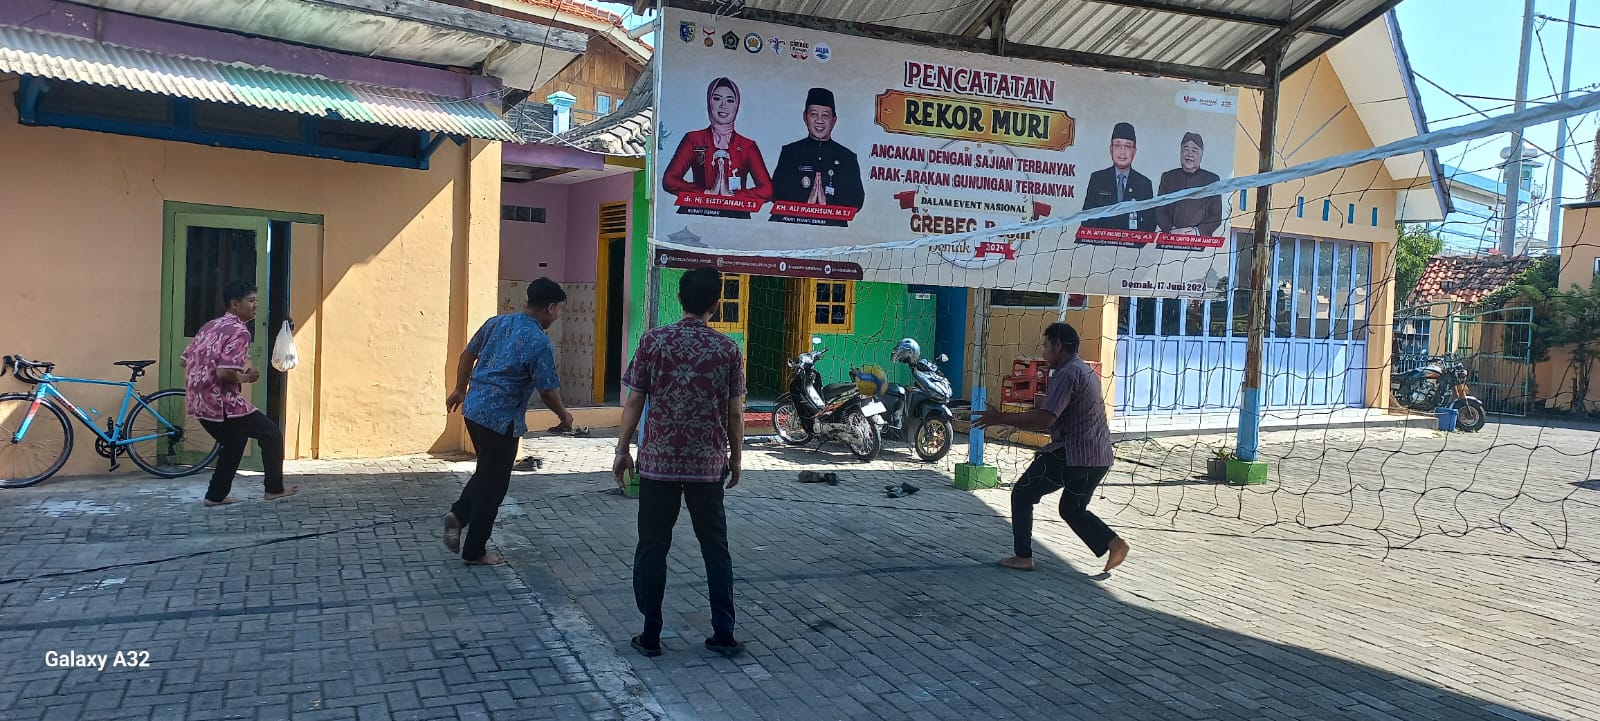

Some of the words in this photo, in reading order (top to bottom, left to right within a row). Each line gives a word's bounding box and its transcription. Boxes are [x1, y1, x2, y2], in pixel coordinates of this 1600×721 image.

[906, 61, 1055, 102] PENCATATAN
[905, 100, 984, 132] REKOR
[991, 109, 1050, 139] MURI
[871, 144, 925, 162] ANCAKAN
[928, 149, 972, 167] DENGAN
[975, 154, 1013, 170] SAJIAN
[1016, 159, 1076, 177] TERBANYAK
[869, 166, 950, 187] ARAK-ARAKAN
[953, 174, 1013, 192] GUNUNGAN
[1016, 180, 1075, 198] TERBANYAK
[921, 197, 952, 207] DALAM
[953, 200, 982, 209] EVENT
[984, 203, 1027, 213] NASIONAL
[985, 243, 1005, 253] 2024
[1122, 280, 1155, 290] Demak,
[1167, 282, 1185, 290] Juni
[1187, 282, 1207, 291] 2024
